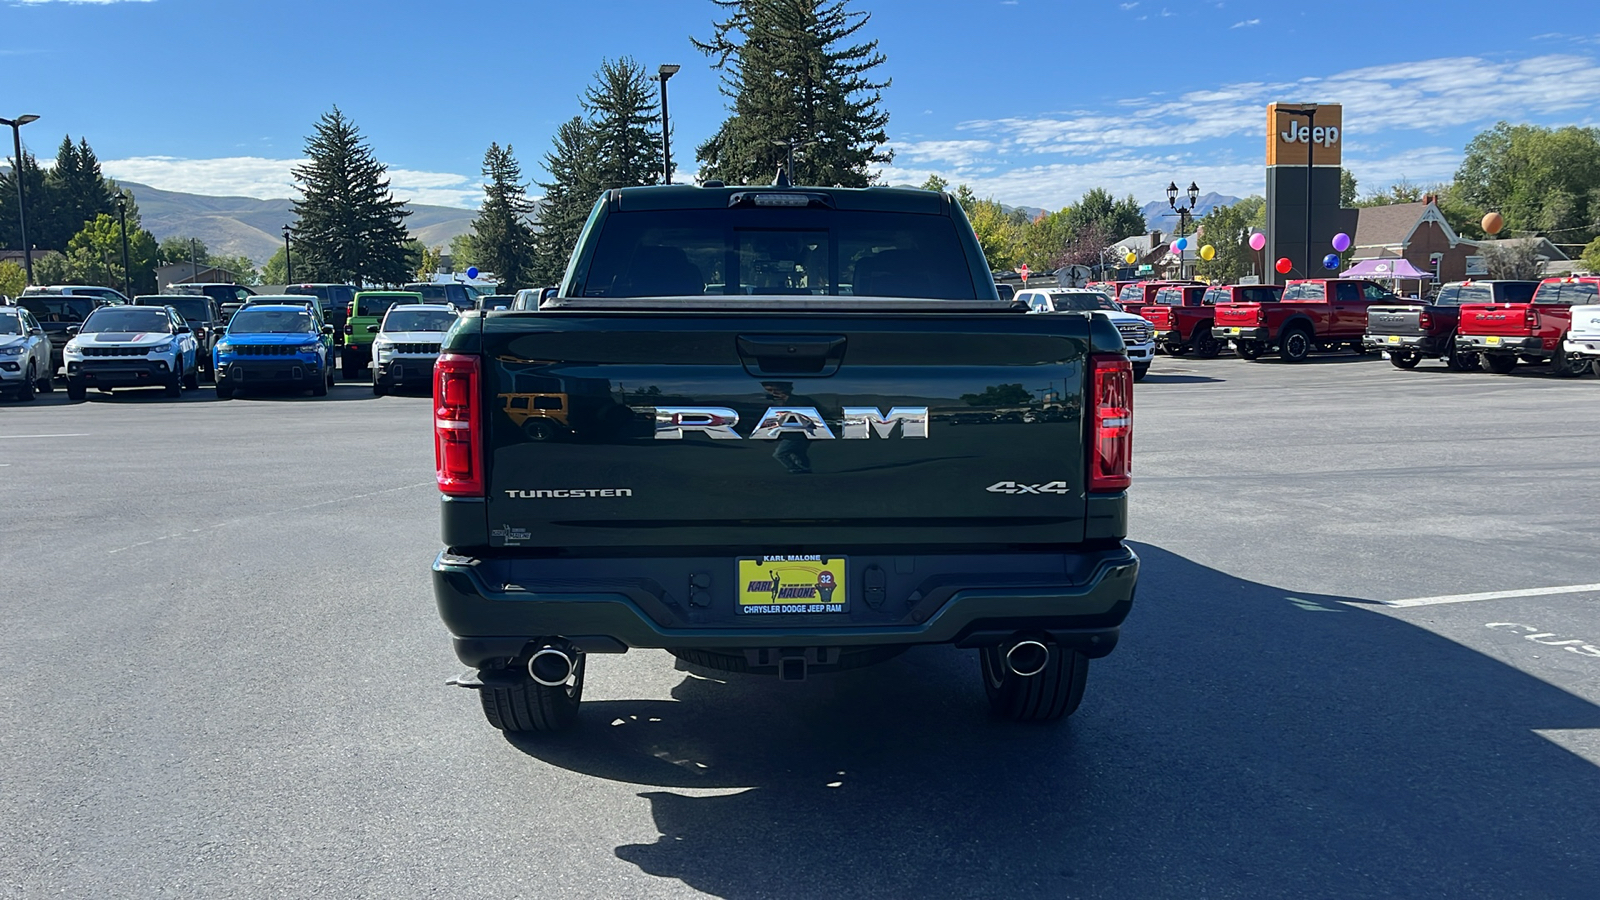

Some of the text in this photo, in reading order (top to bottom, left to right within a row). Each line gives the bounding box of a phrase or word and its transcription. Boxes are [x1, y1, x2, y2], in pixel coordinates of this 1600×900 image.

[1281, 120, 1339, 147] Jeep
[654, 406, 929, 439] RAM
[986, 481, 1070, 494] 4x4
[505, 489, 632, 498] TUNGSTEN
[821, 575, 831, 583] 32
[747, 581, 772, 592] KARL
[778, 587, 816, 598] MALONE
[744, 604, 842, 614] CHRYSLER DODGE JEEP RAM
